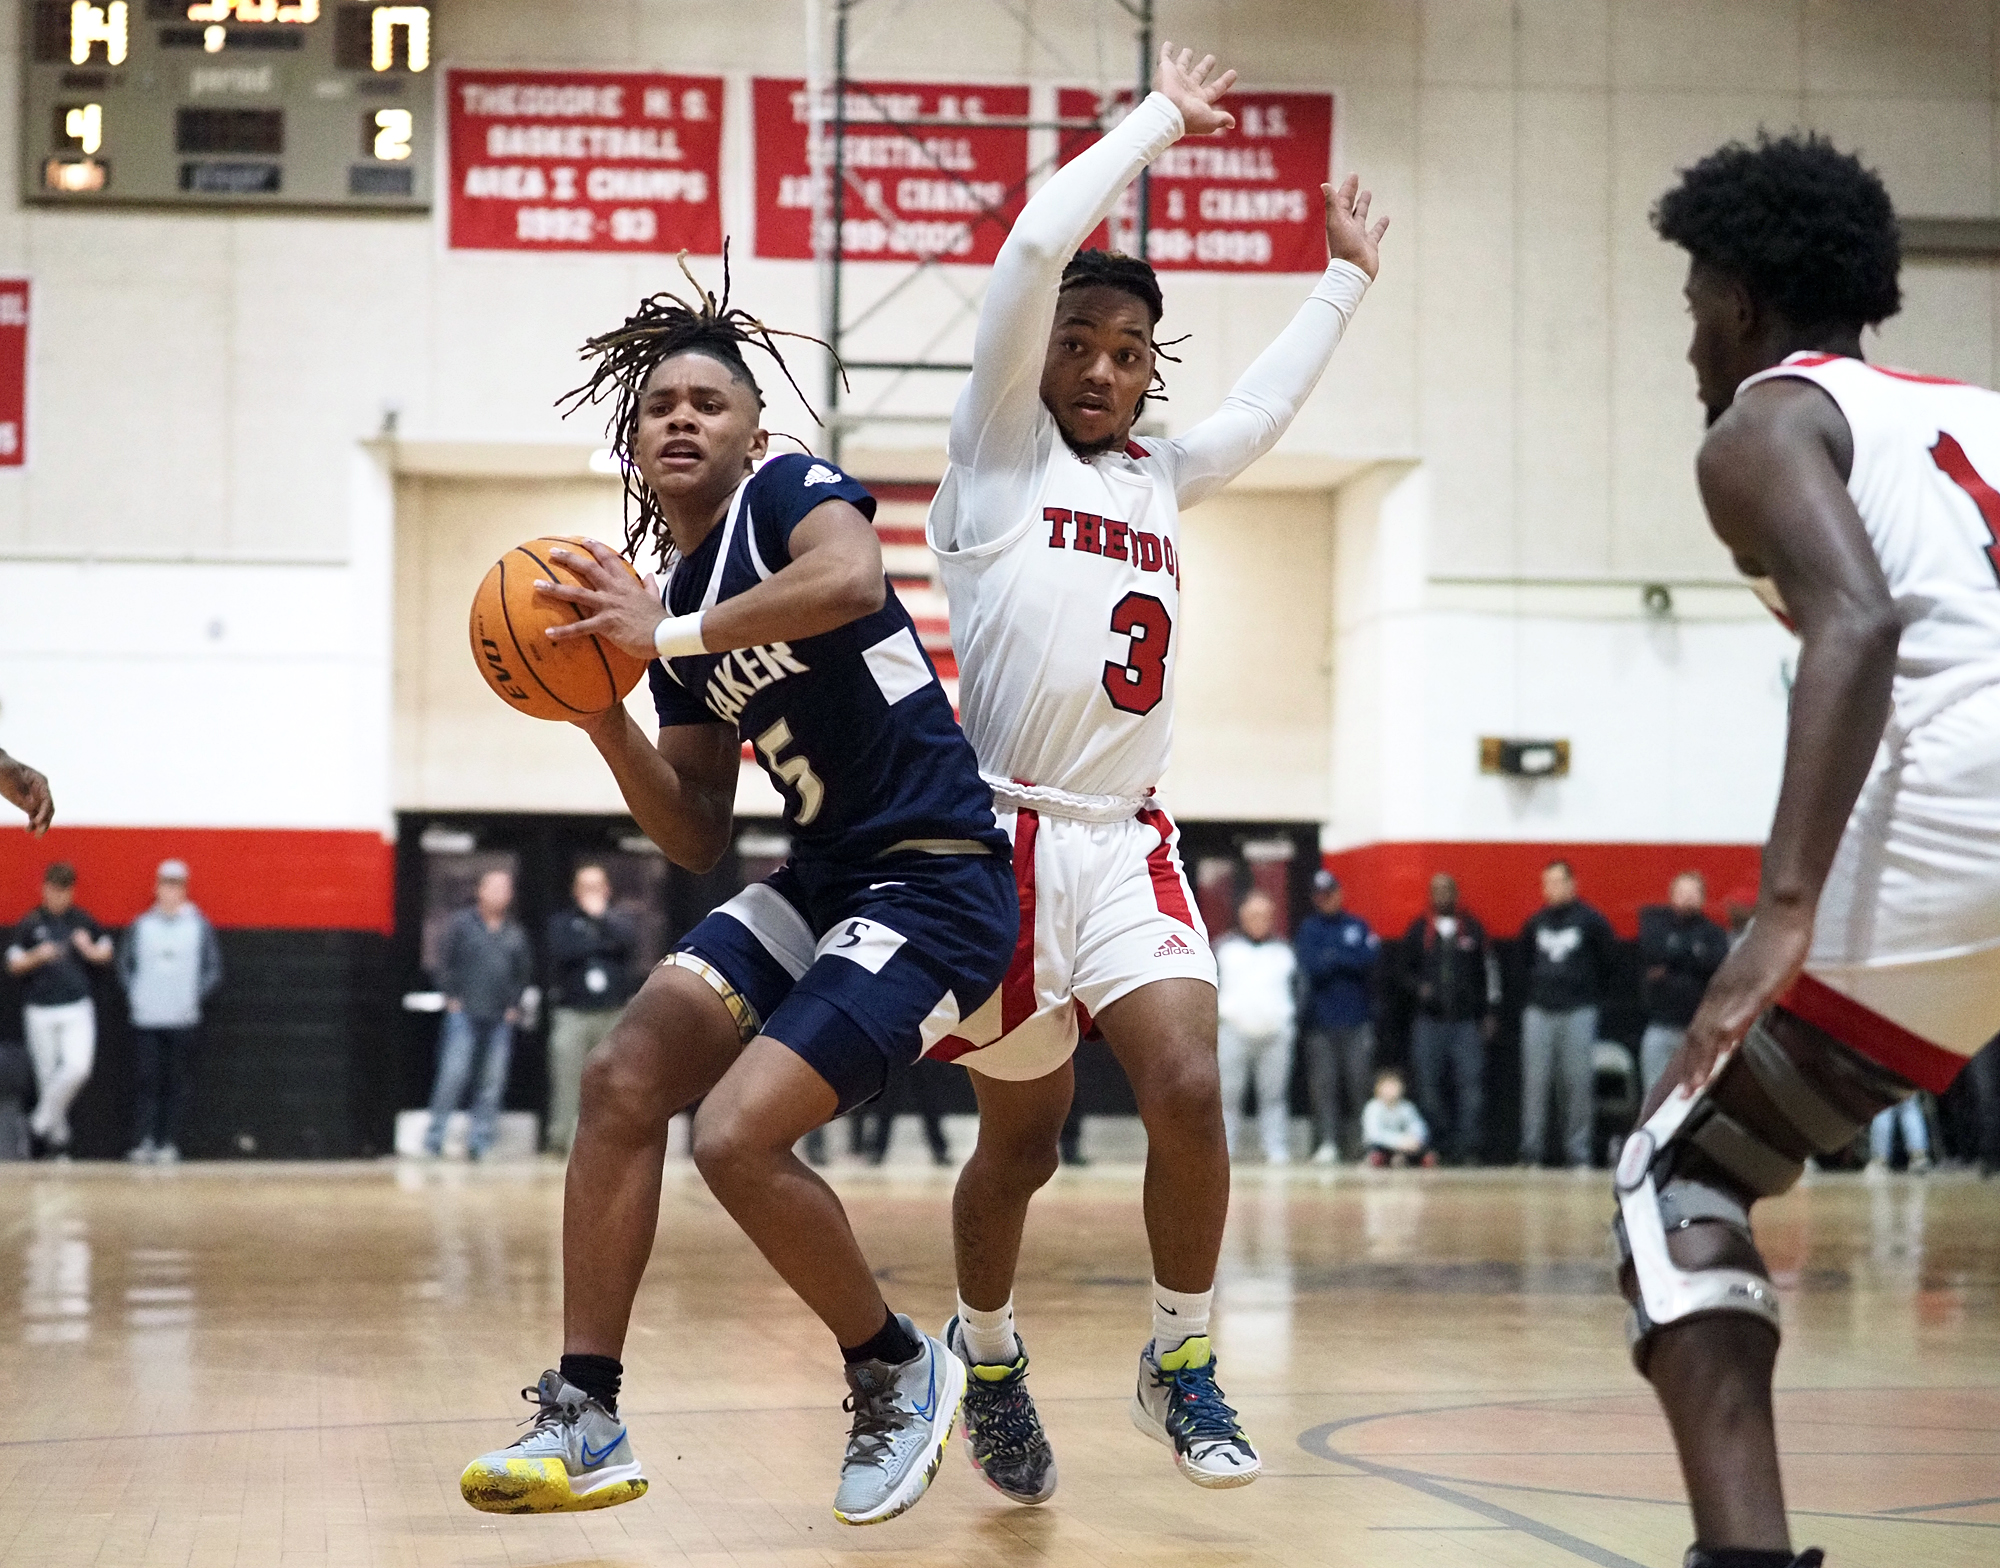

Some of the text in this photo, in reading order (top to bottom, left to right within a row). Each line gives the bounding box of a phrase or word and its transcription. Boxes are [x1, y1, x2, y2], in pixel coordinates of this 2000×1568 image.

[65, 103, 102, 154] 4
[374, 108, 412, 160] 2
[486, 124, 684, 162] BASKETBALL
[586, 167, 708, 204] CHAMPS
[1199, 189, 1309, 223] CHAMPS
[481, 638, 530, 700] EVO
[1102, 591, 1172, 716] 3
[755, 716, 825, 827] 5
[836, 920, 871, 949] 5
[1153, 946, 1196, 958] adidas
